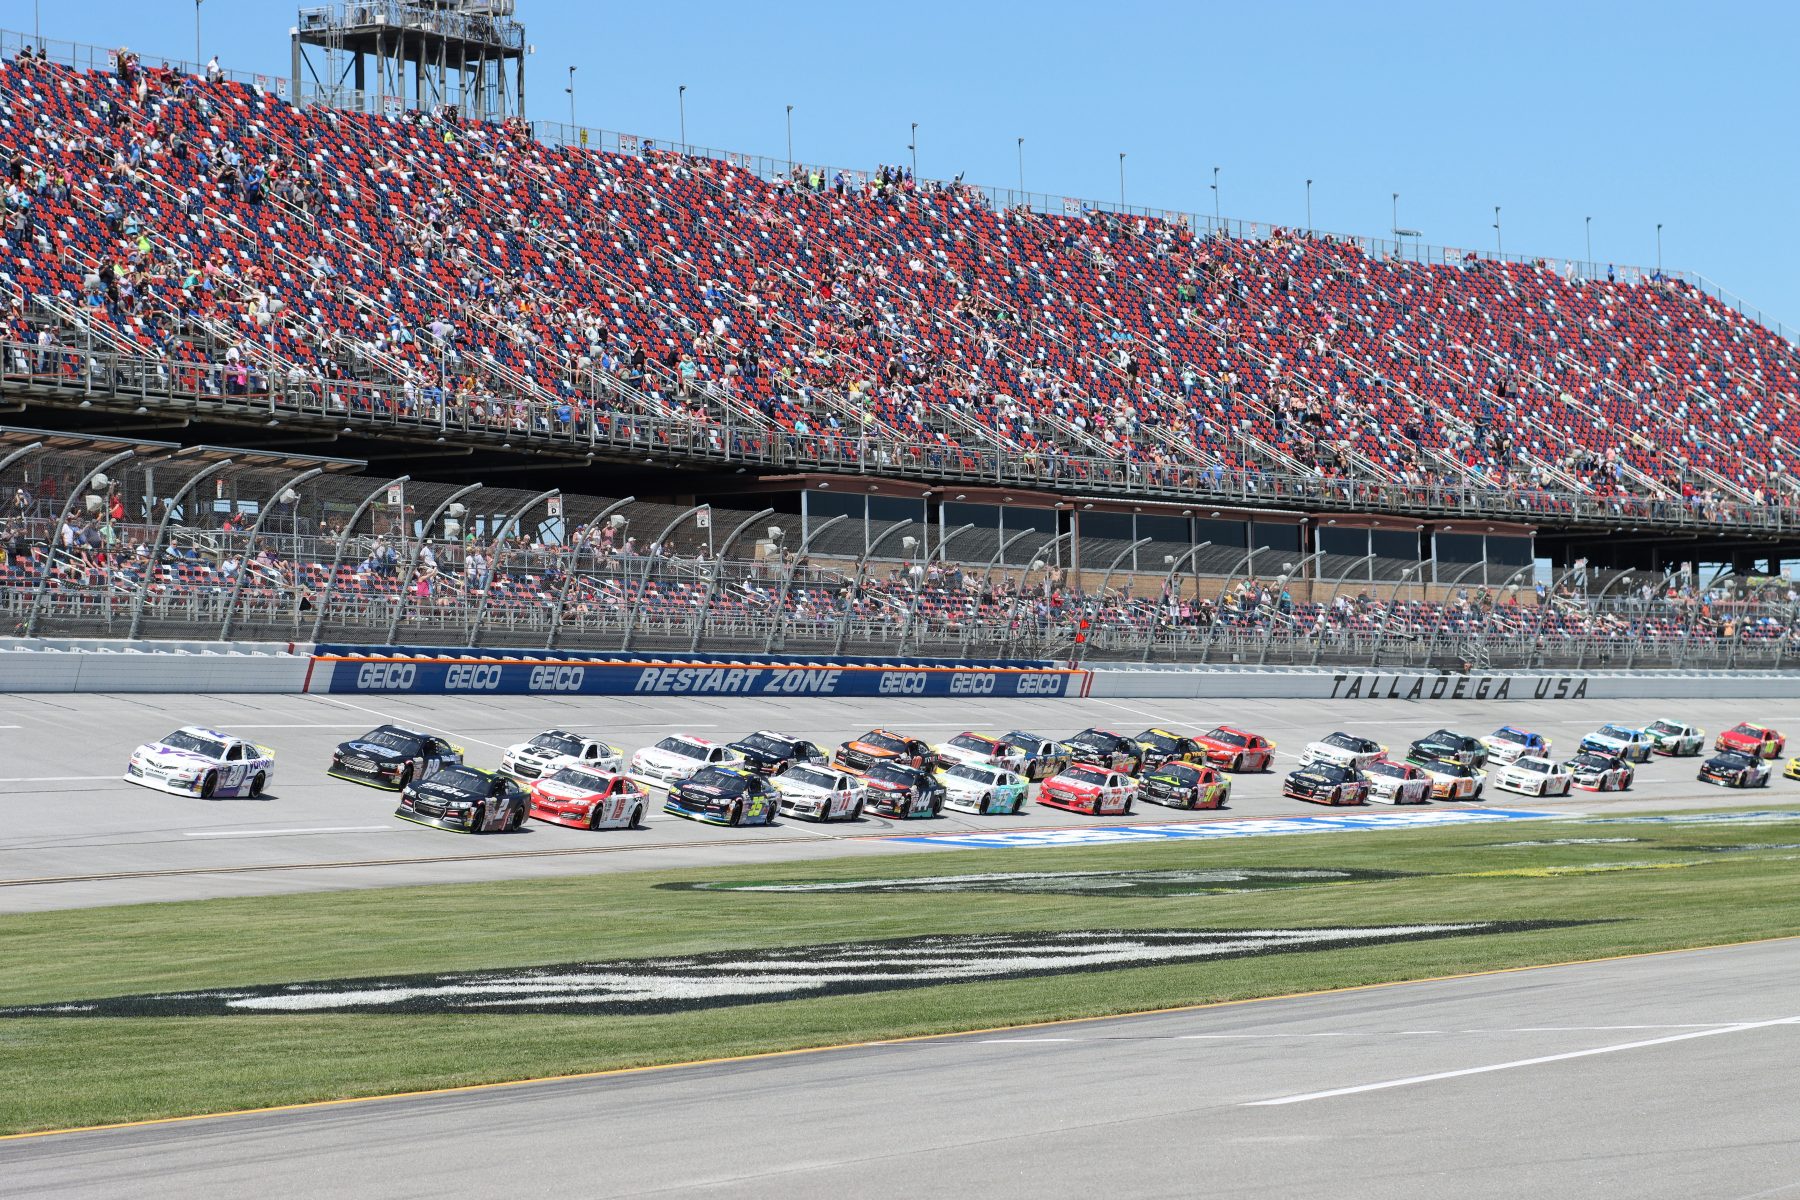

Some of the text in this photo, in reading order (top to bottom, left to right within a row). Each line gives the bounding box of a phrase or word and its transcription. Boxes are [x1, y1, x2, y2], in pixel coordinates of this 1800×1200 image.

[357, 662, 417, 689] GEICO
[444, 664, 503, 689] GEICO
[528, 666, 585, 691] GEICO
[634, 667, 844, 693] RESTART ZONE
[878, 671, 927, 694] GEICO
[949, 672, 996, 694] GEICO
[1016, 673, 1062, 694] GEICO
[1330, 675, 1589, 699] TALLADEGA USA
[916, 790, 932, 811] 44
